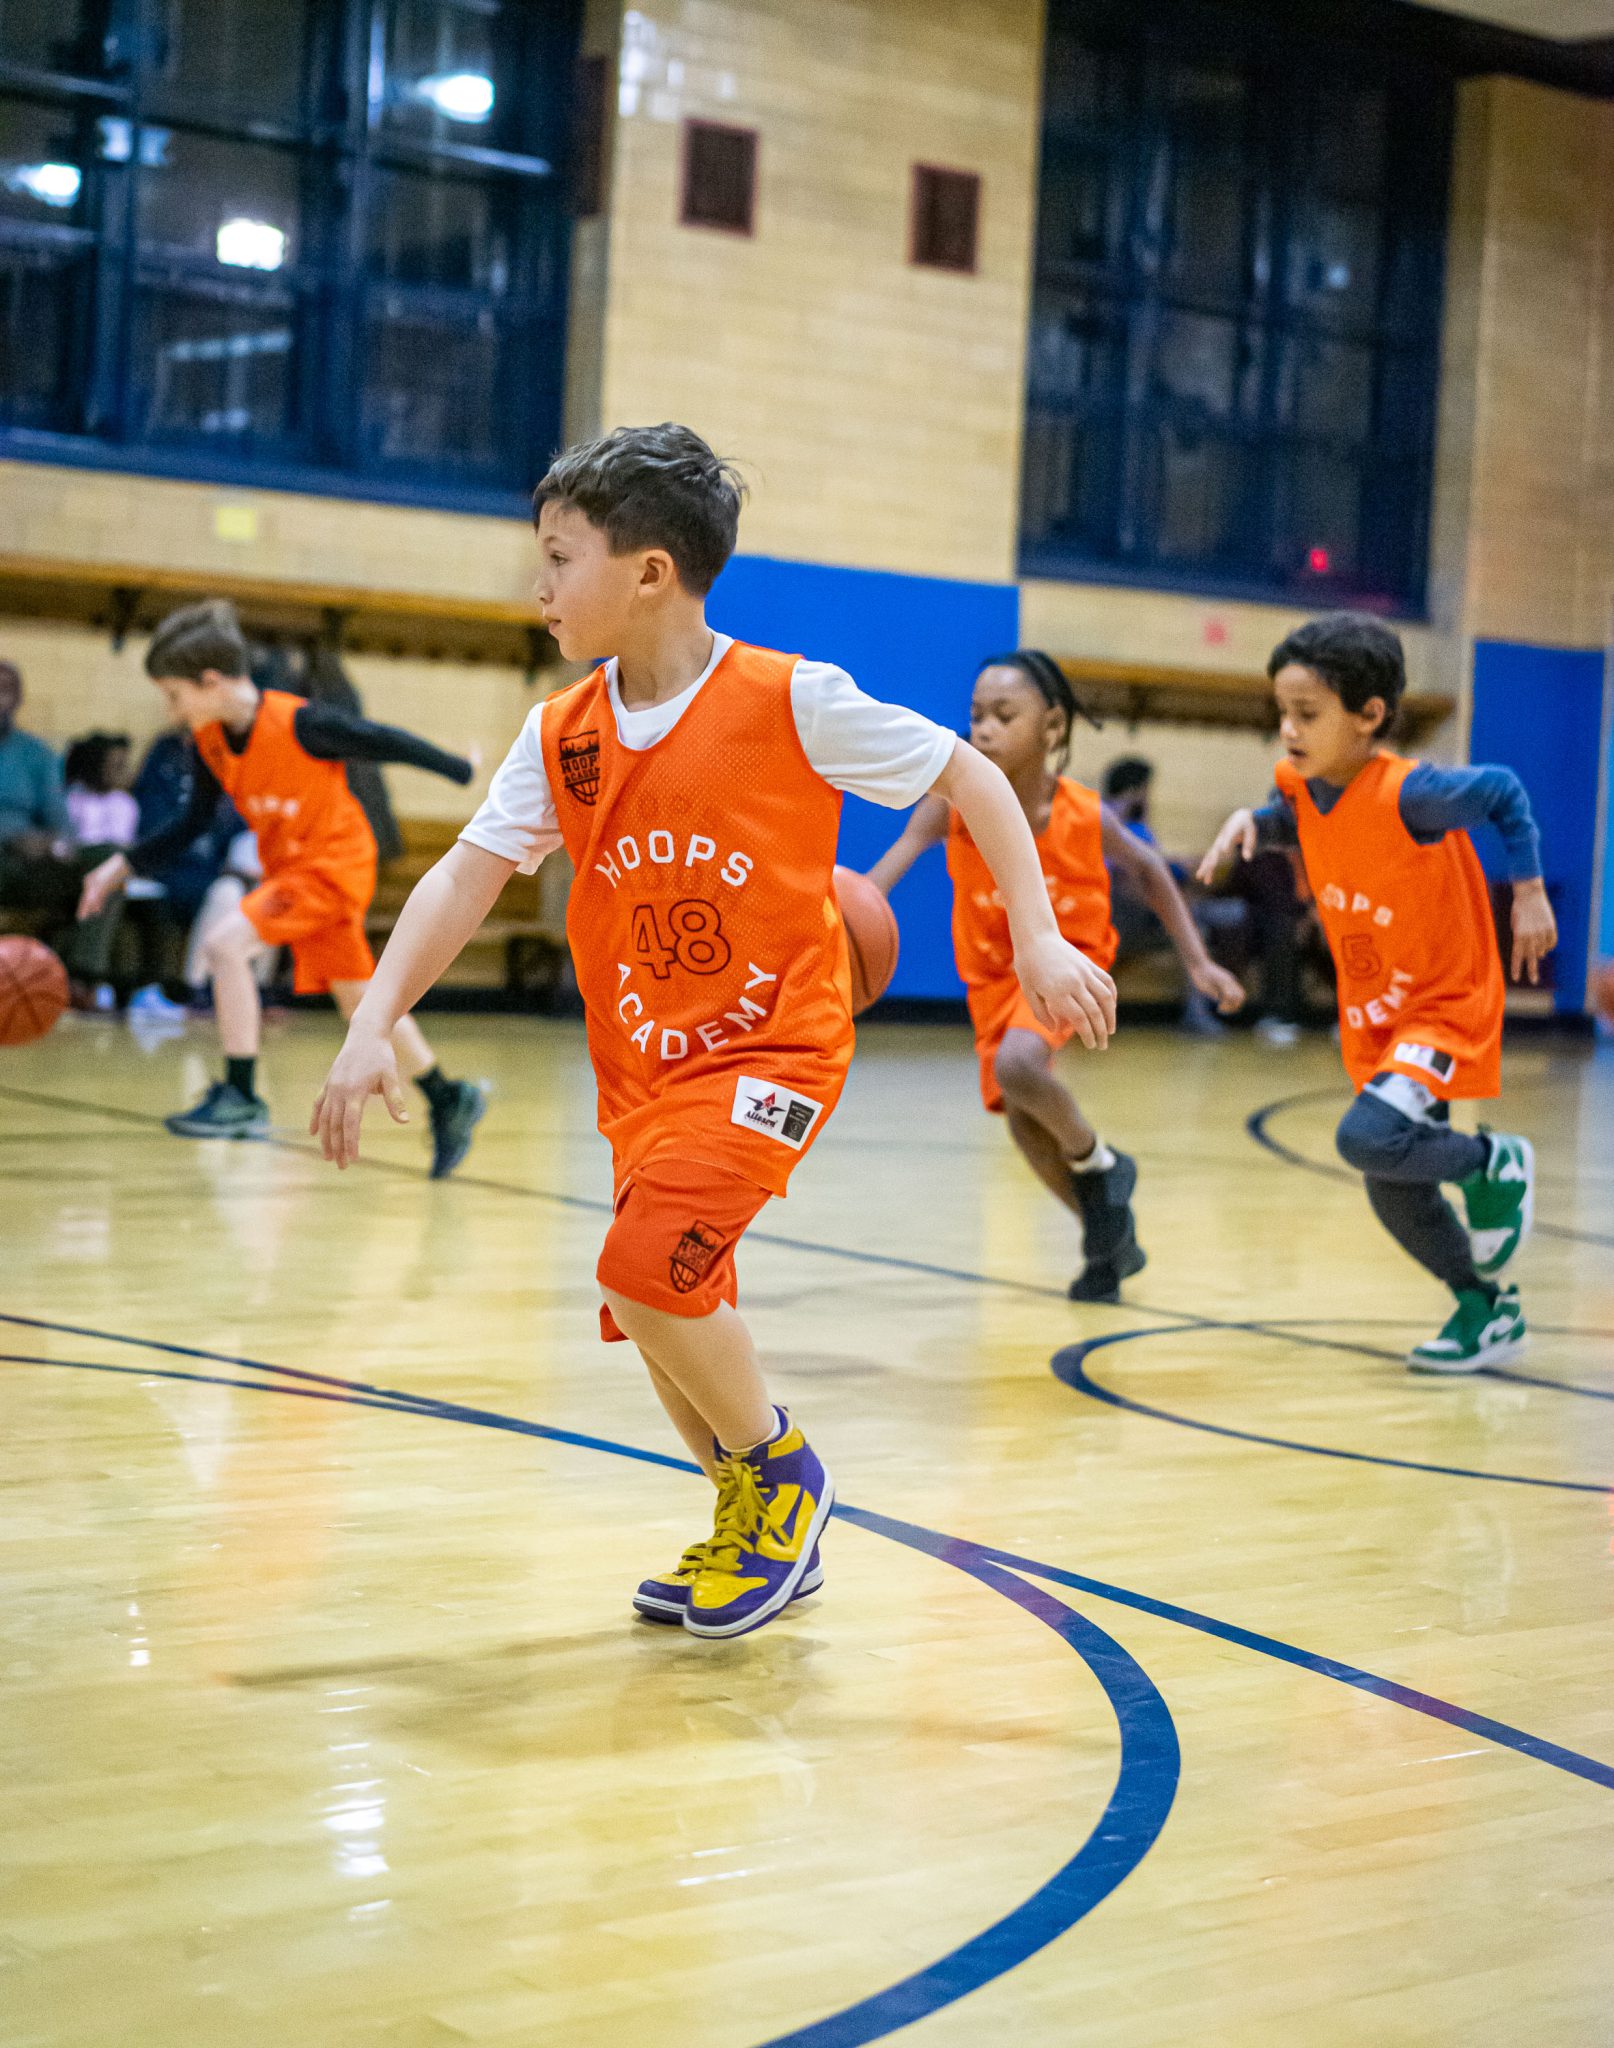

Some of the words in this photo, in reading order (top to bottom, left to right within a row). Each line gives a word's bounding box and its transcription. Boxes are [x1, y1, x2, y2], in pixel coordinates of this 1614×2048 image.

[561, 753, 599, 774] HOOP
[594, 830, 754, 889] HOOPS
[632, 899, 731, 980] 48
[617, 961, 778, 1060] ACADEMY
